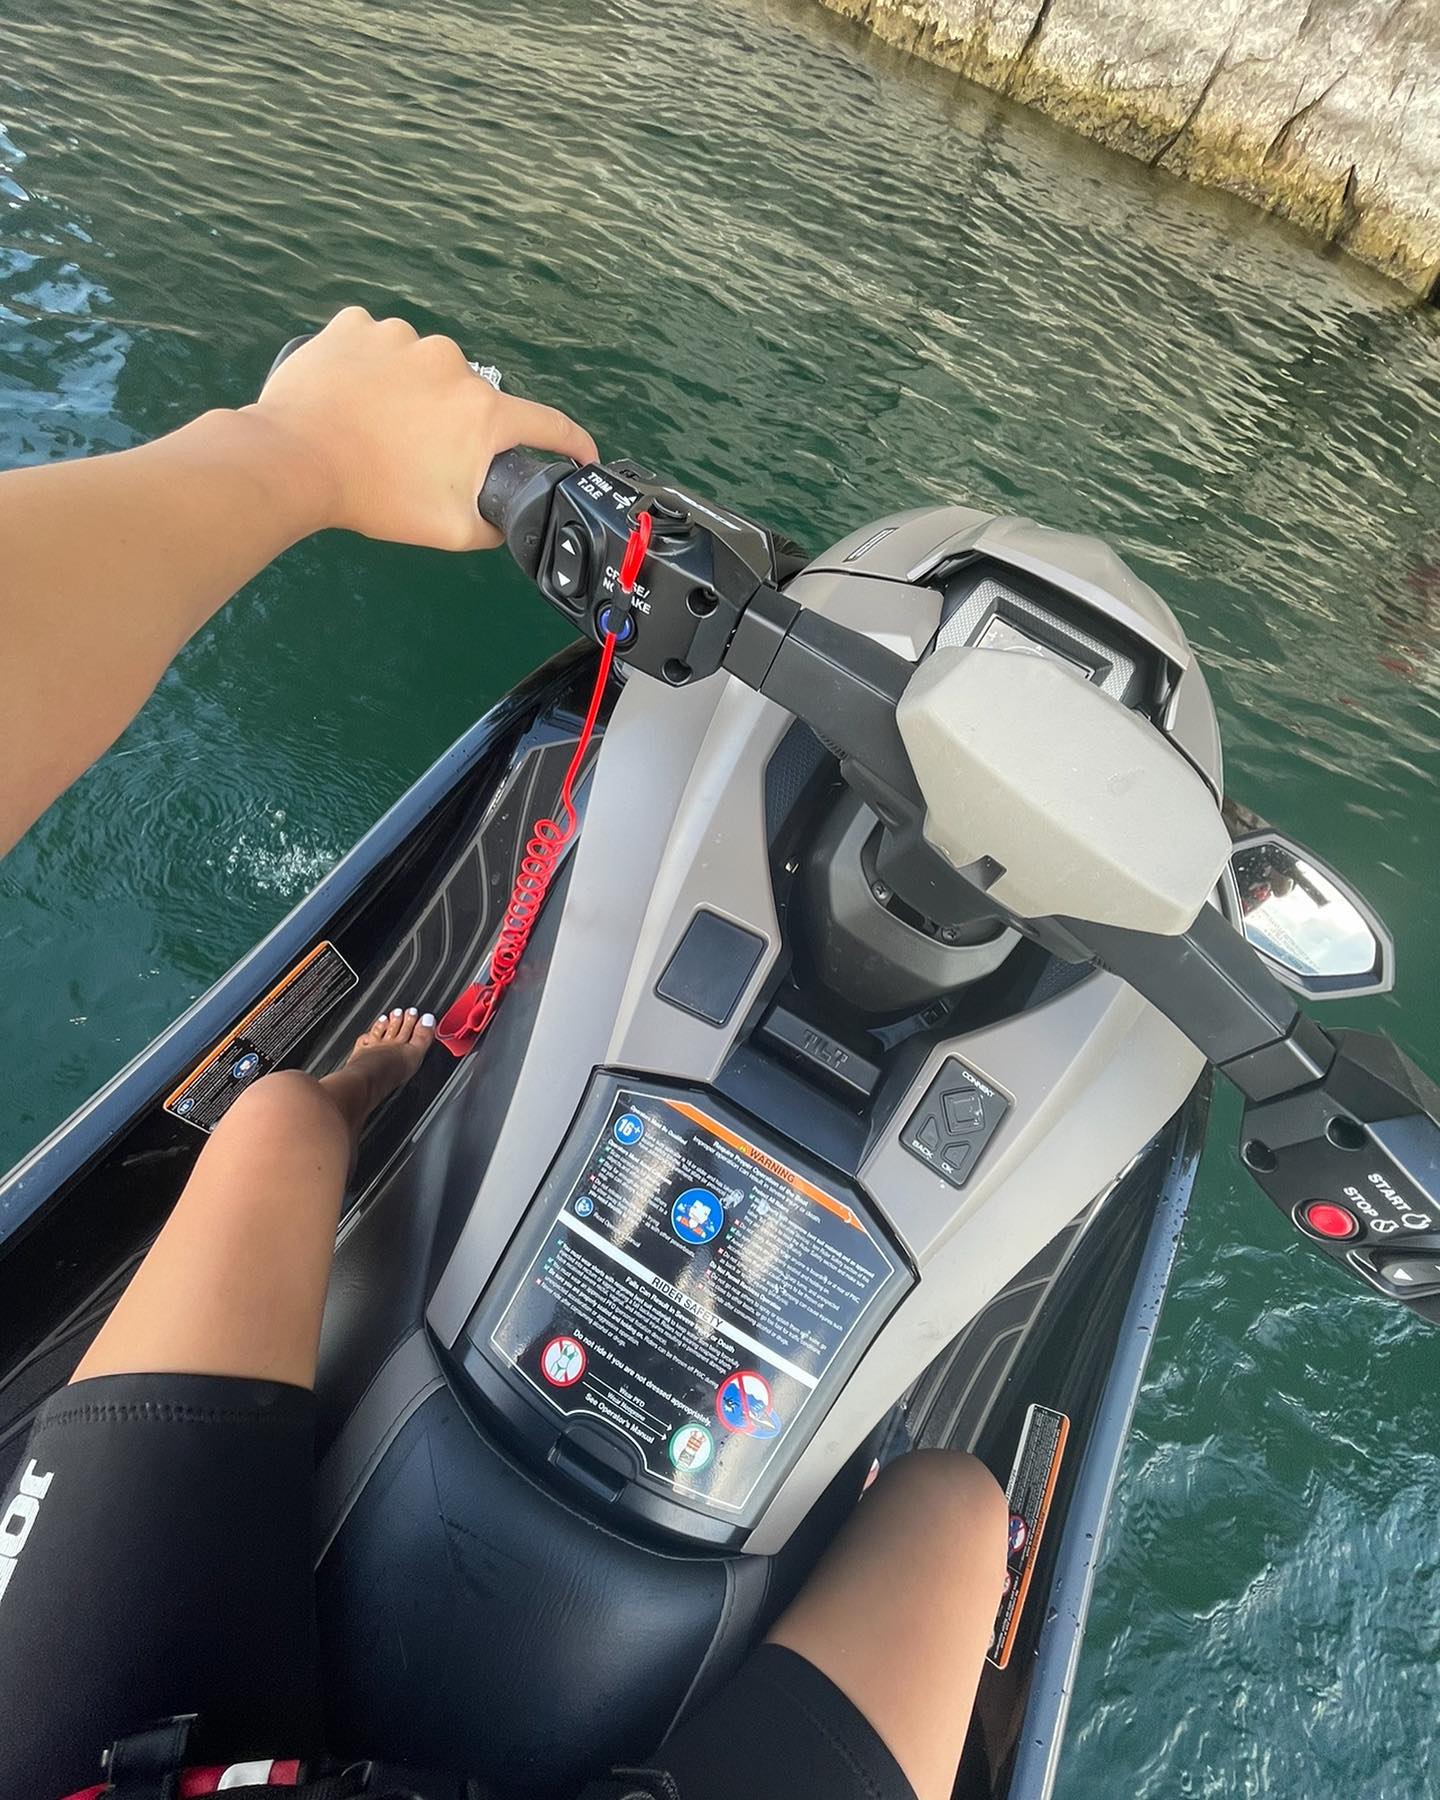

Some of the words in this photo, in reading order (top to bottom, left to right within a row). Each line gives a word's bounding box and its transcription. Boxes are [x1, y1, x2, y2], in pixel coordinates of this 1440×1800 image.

[576, 478, 603, 500] T.D.E
[587, 471, 613, 493] TRIM
[631, 596, 651, 614] AKE
[912, 1140, 933, 1159] BACK
[748, 1148, 795, 1183] WARNING
[941, 1162, 954, 1174] OK
[1343, 1186, 1378, 1217] STOP
[1368, 1173, 1411, 1212] START
[651, 1276, 684, 1302] RIDER
[683, 1297, 723, 1328] SAFETY
[572, 1328, 584, 1340] Do
[582, 1335, 595, 1348] not
[593, 1343, 608, 1356] ride
[606, 1351, 613, 1360] if
[611, 1354, 625, 1368] you
[623, 1363, 636, 1375] are
[634, 1370, 648, 1383] not
[645, 1378, 672, 1399] dressed
[670, 1394, 713, 1427] appropriately.
[605, 1391, 621, 1405] Wear
[619, 1401, 646, 1422] Neoprene
[617, 1387, 633, 1400] Wear
[631, 1396, 645, 1408] PFD
[584, 1392, 598, 1406] See
[596, 1401, 631, 1428] Operator's
[629, 1423, 655, 1444] Manual
